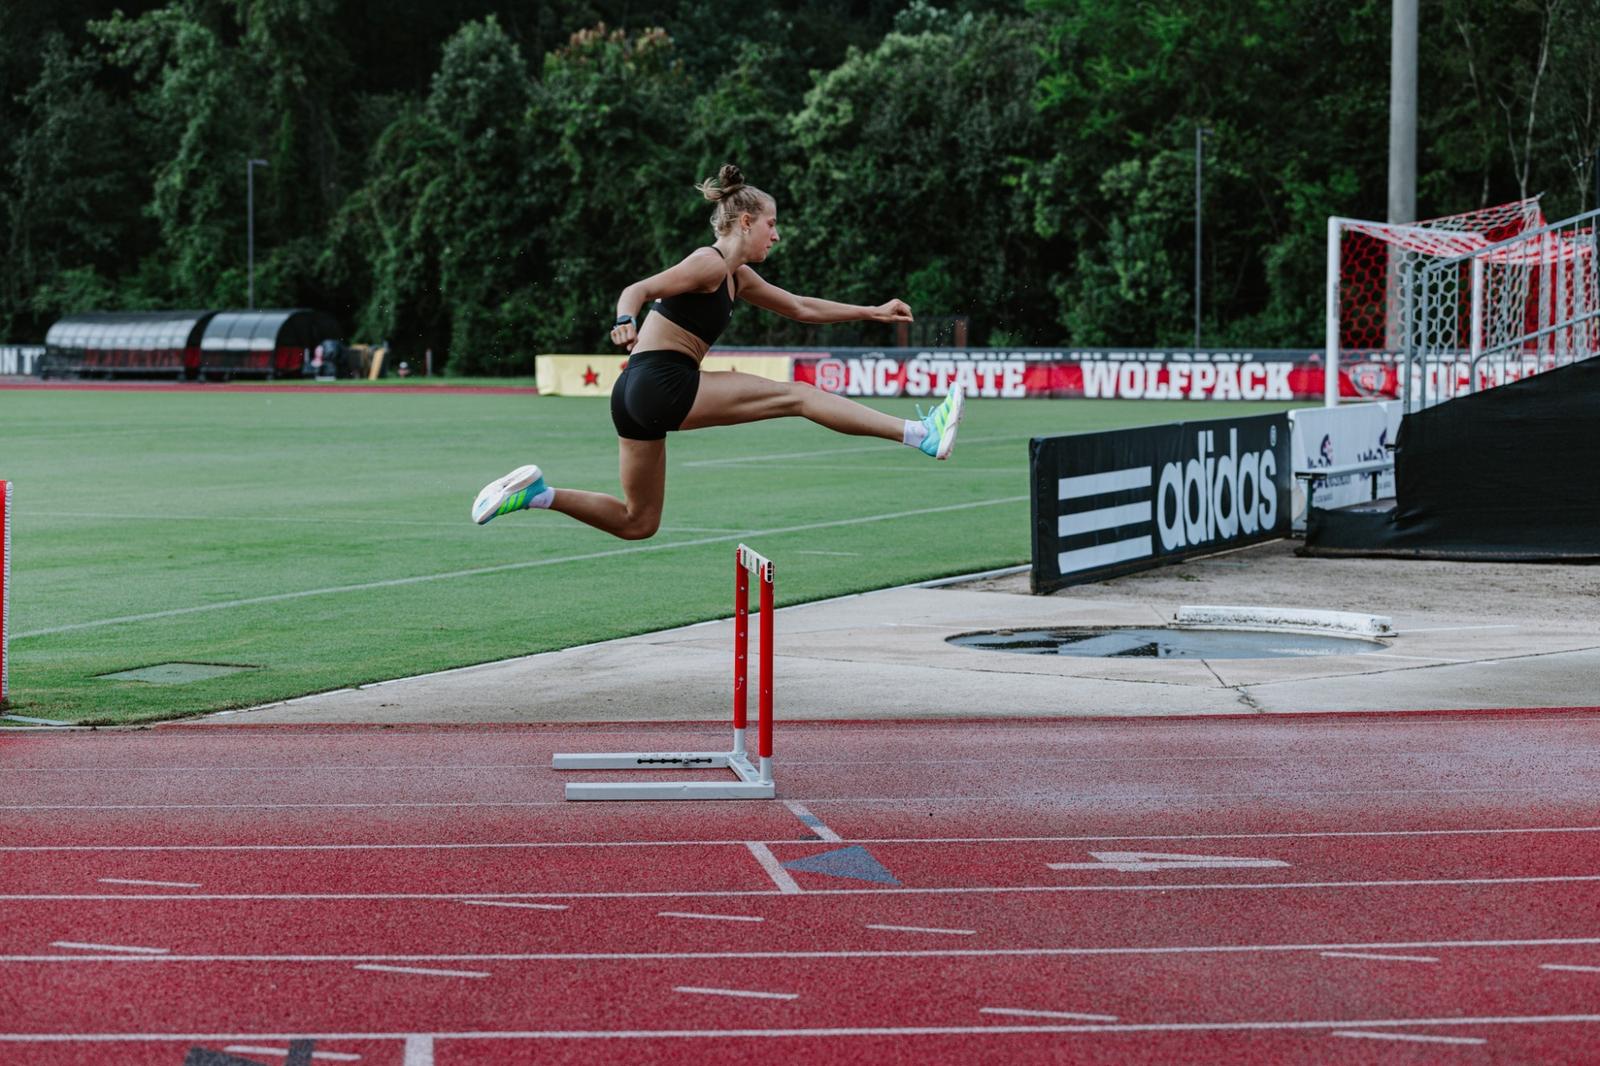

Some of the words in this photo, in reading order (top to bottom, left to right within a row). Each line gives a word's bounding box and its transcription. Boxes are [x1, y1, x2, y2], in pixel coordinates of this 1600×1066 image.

[847, 358, 899, 396] NC
[905, 359, 1026, 398] STATE
[1080, 360, 1294, 400] WOLFPACK
[1157, 427, 1278, 551] adidas
